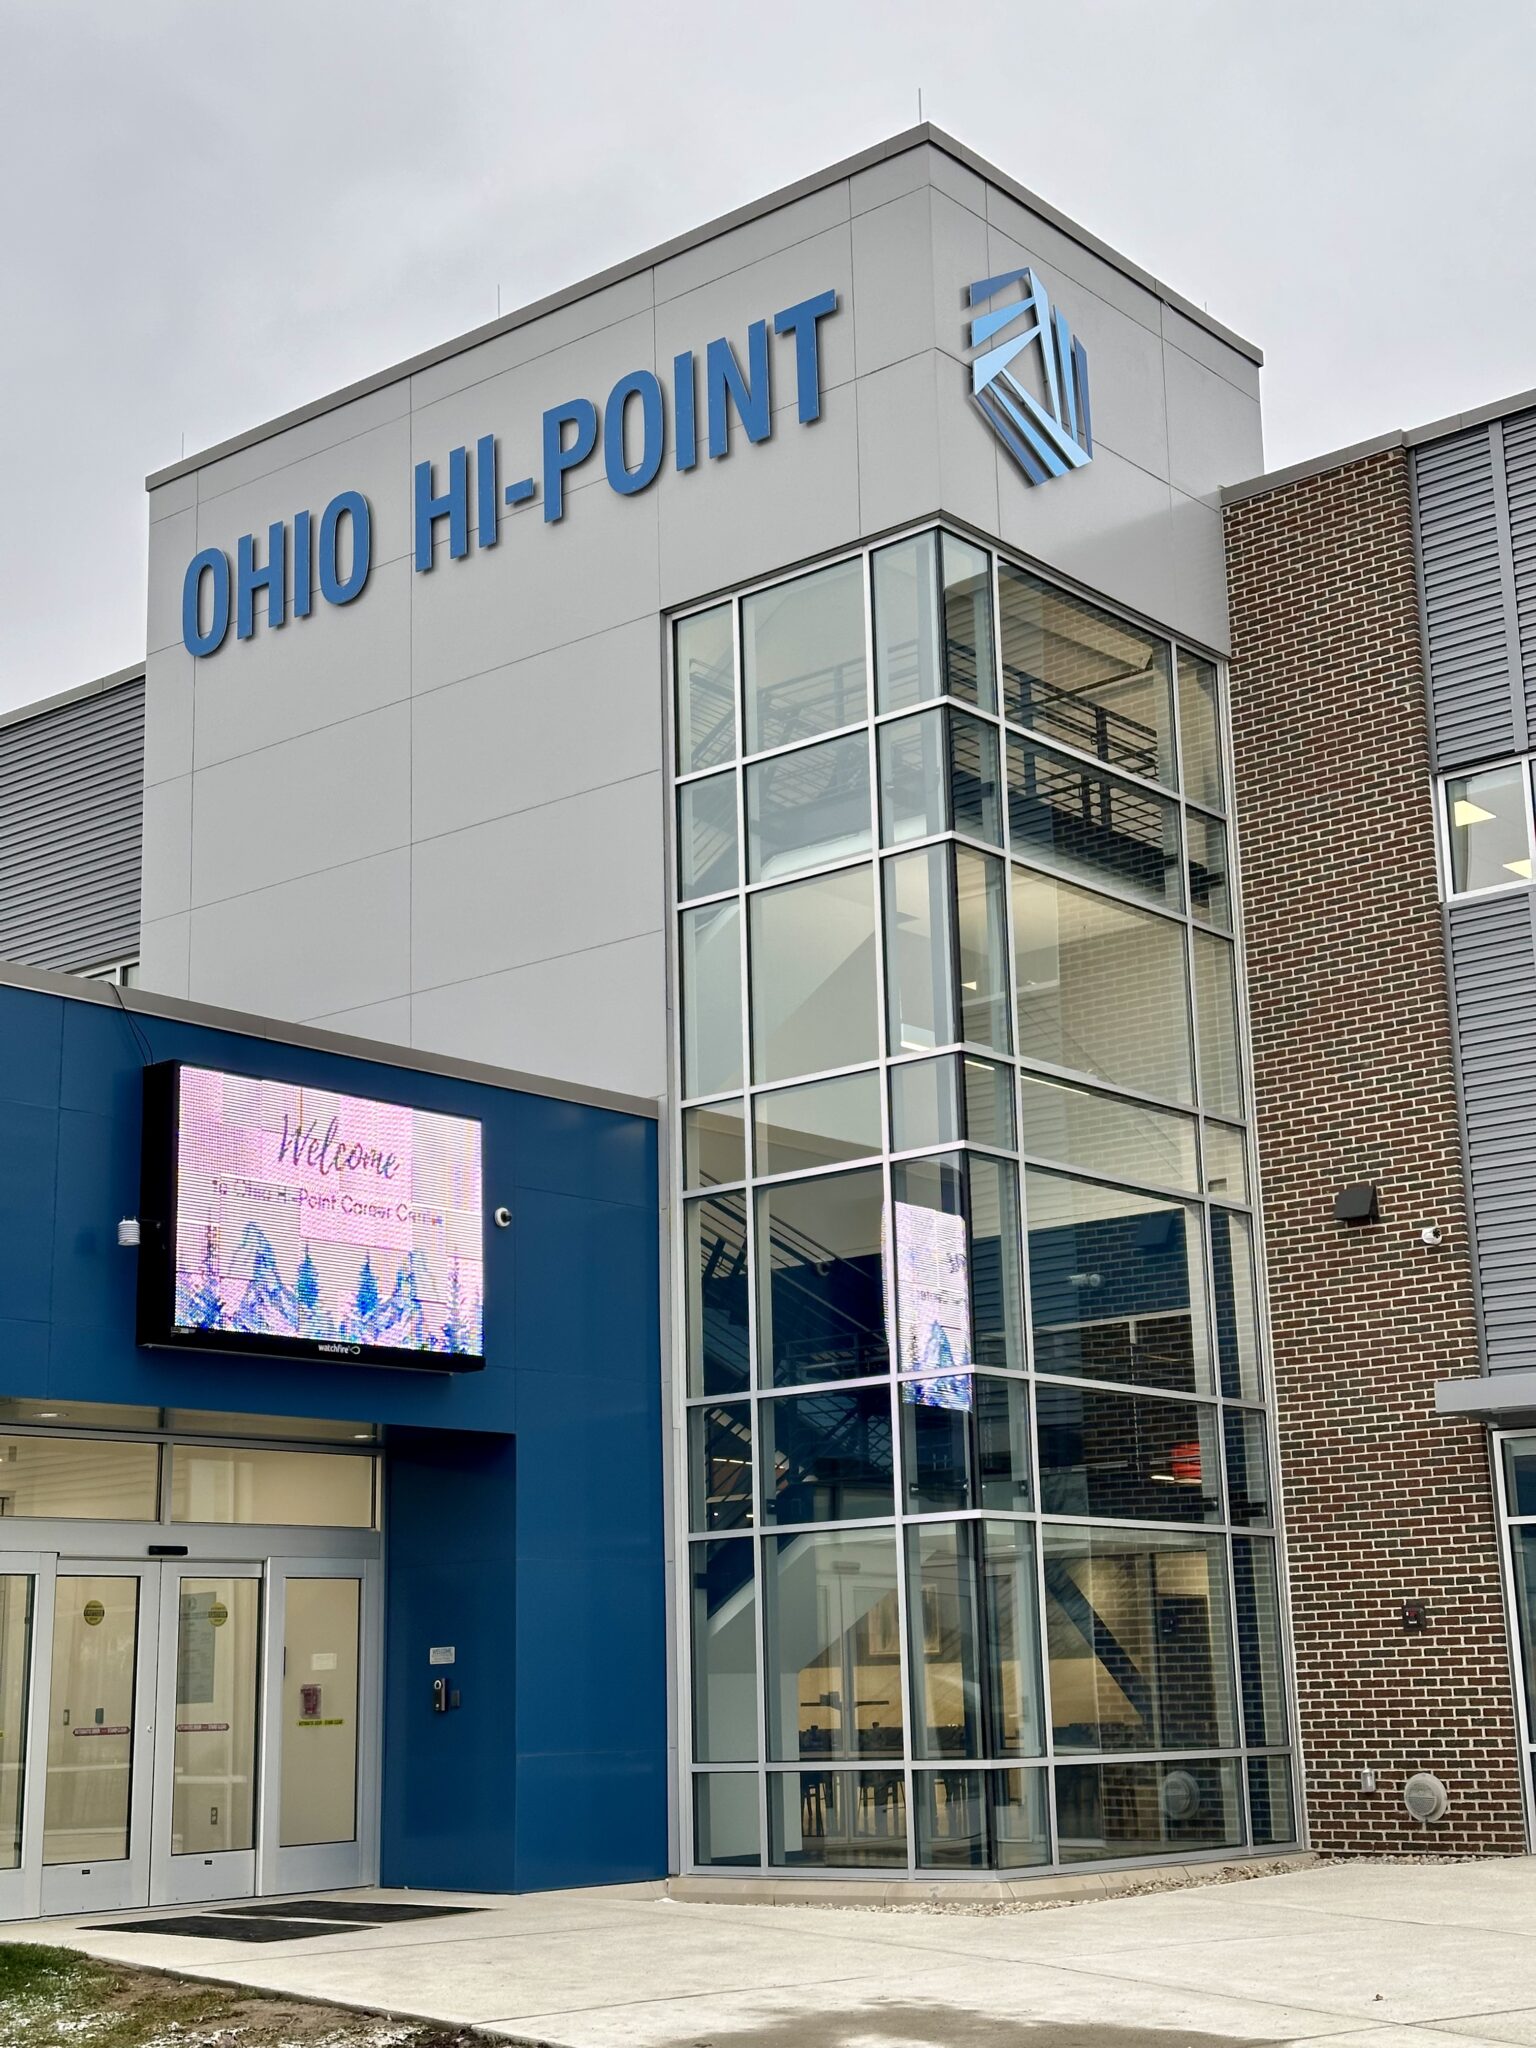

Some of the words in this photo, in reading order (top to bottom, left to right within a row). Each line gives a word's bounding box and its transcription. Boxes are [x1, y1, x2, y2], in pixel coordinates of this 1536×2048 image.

[182, 490, 371, 658] OHIO
[414, 289, 838, 574] HI-POINT
[278, 1113, 400, 1180] Welcome
[318, 1344, 349, 1354] watchfire
